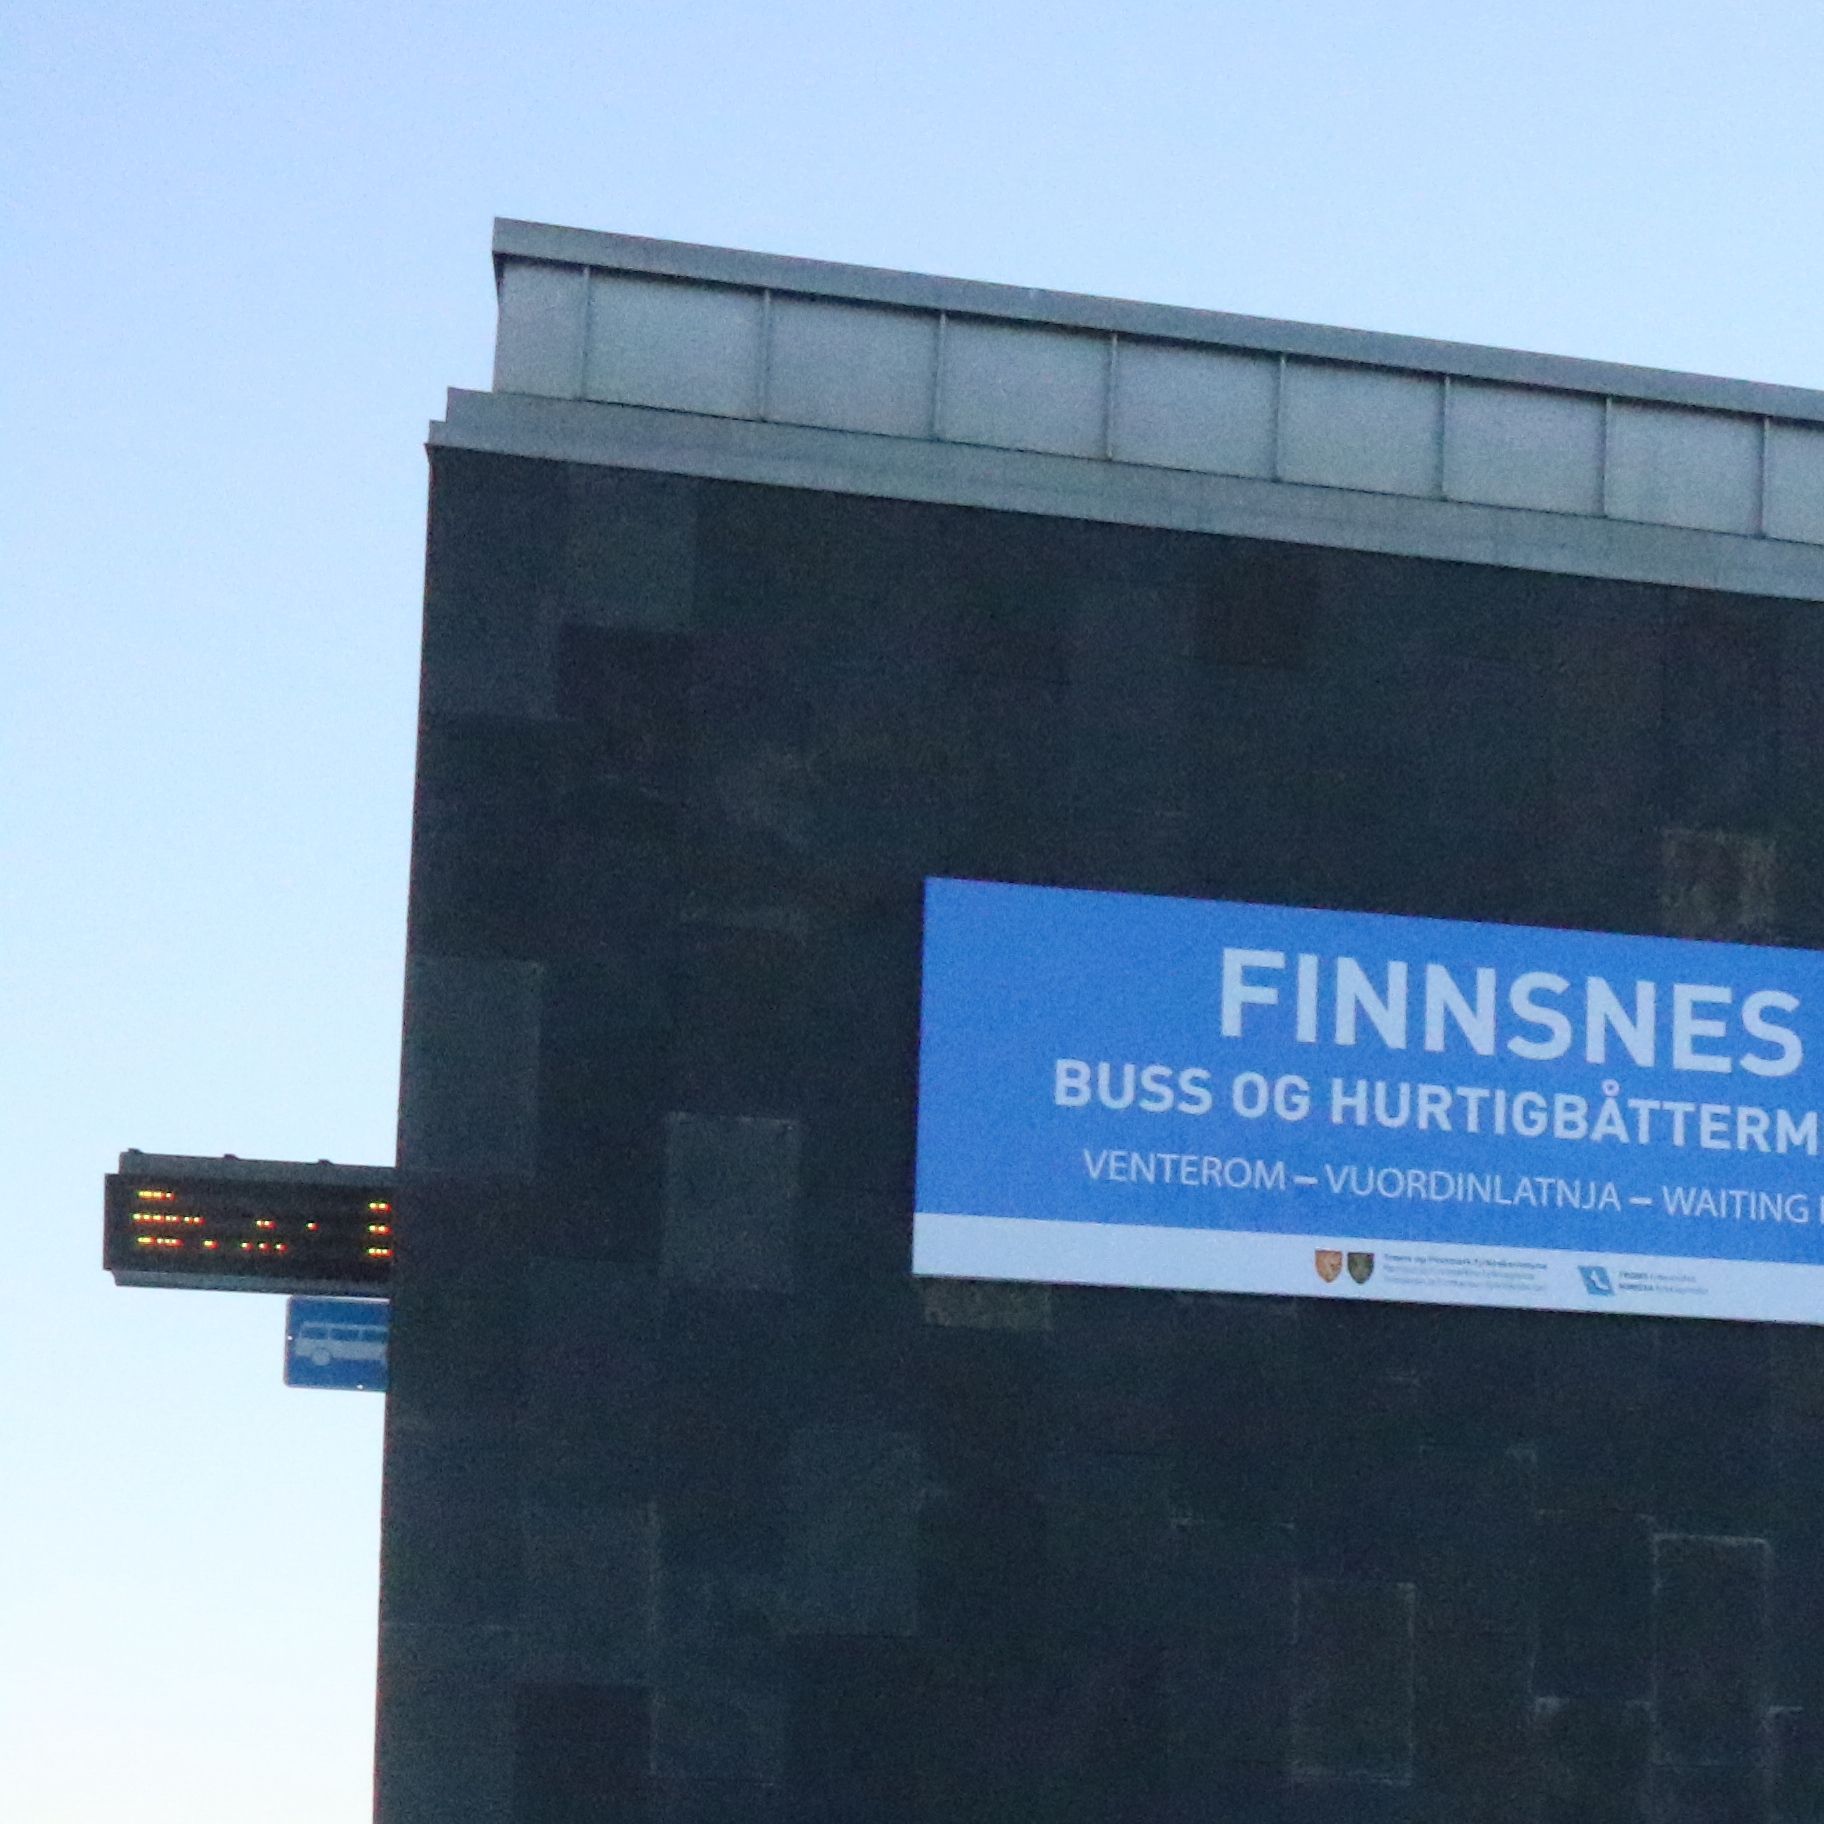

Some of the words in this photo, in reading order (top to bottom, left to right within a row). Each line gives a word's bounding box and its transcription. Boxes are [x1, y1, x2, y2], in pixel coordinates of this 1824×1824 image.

[1221, 948, 1803, 1077] FINNSNES
[1055, 1059, 1213, 1115] BUSS
[1232, 1072, 1310, 1122] OG
[1083, 1148, 1286, 1190] VENTEROM
[1324, 1163, 1621, 1213] VUORDINLATNJA
[1663, 1186, 1810, 1224] WAITING
